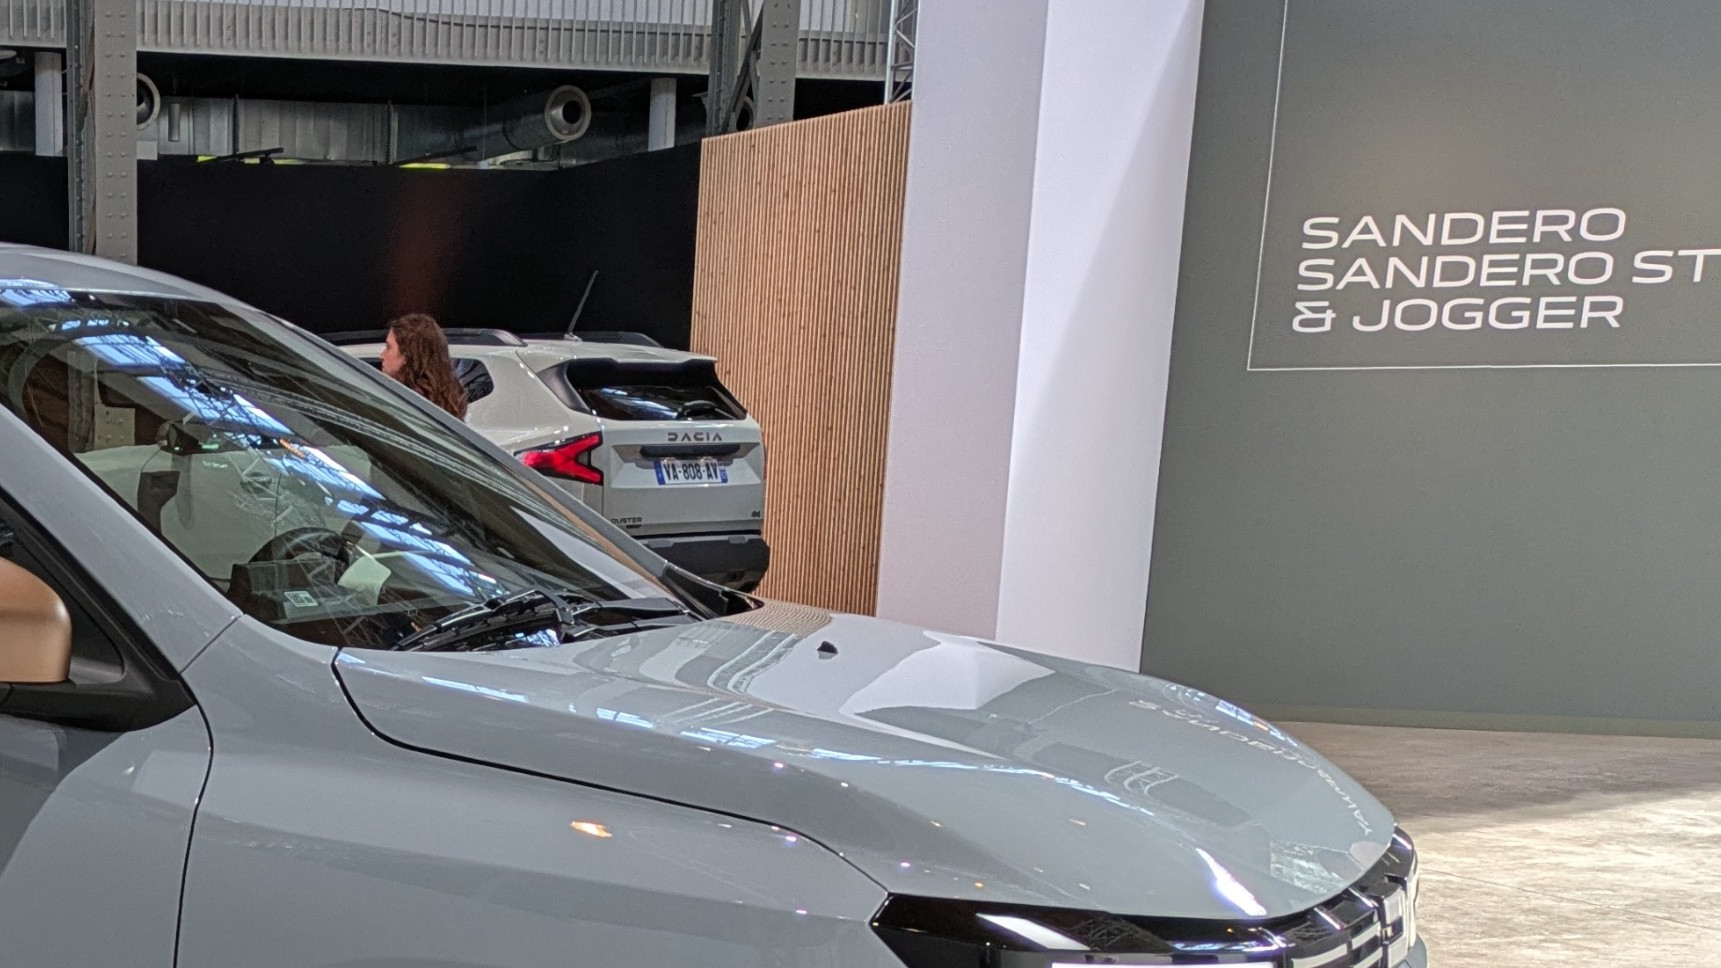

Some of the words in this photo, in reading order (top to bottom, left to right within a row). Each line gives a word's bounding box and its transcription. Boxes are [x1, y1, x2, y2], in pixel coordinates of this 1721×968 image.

[1302, 208, 1626, 249] SANDERO
[1296, 251, 1615, 291] SANDERO
[1630, 248, 1721, 285] ST
[1291, 300, 1337, 333] &
[1352, 295, 1625, 332] JOGGER
[667, 431, 723, 442] DACIA
[663, 462, 719, 481] VA-808-AV
